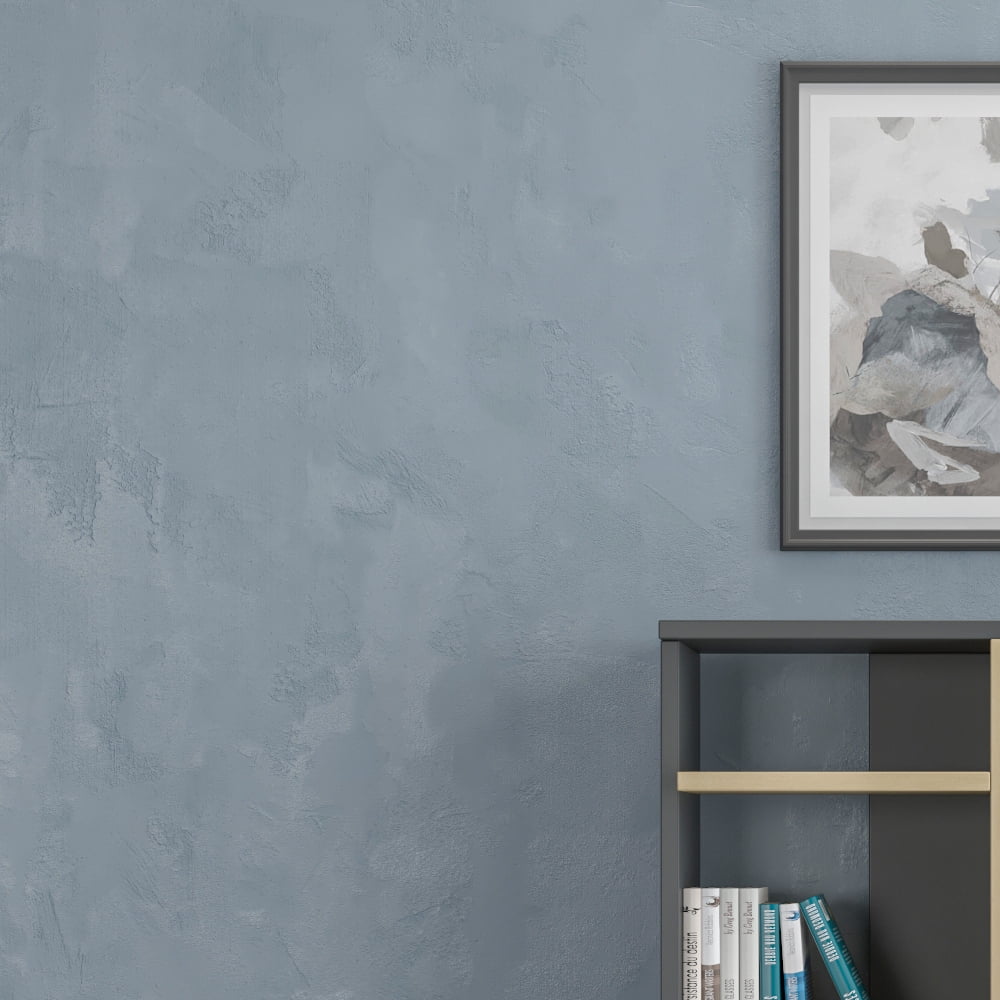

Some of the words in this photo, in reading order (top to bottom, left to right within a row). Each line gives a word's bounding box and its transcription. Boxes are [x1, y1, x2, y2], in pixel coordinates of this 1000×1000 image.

[682, 956, 698, 967] du
[725, 978, 734, 1000] GLASSES
[745, 978, 754, 1000] GLASSES
